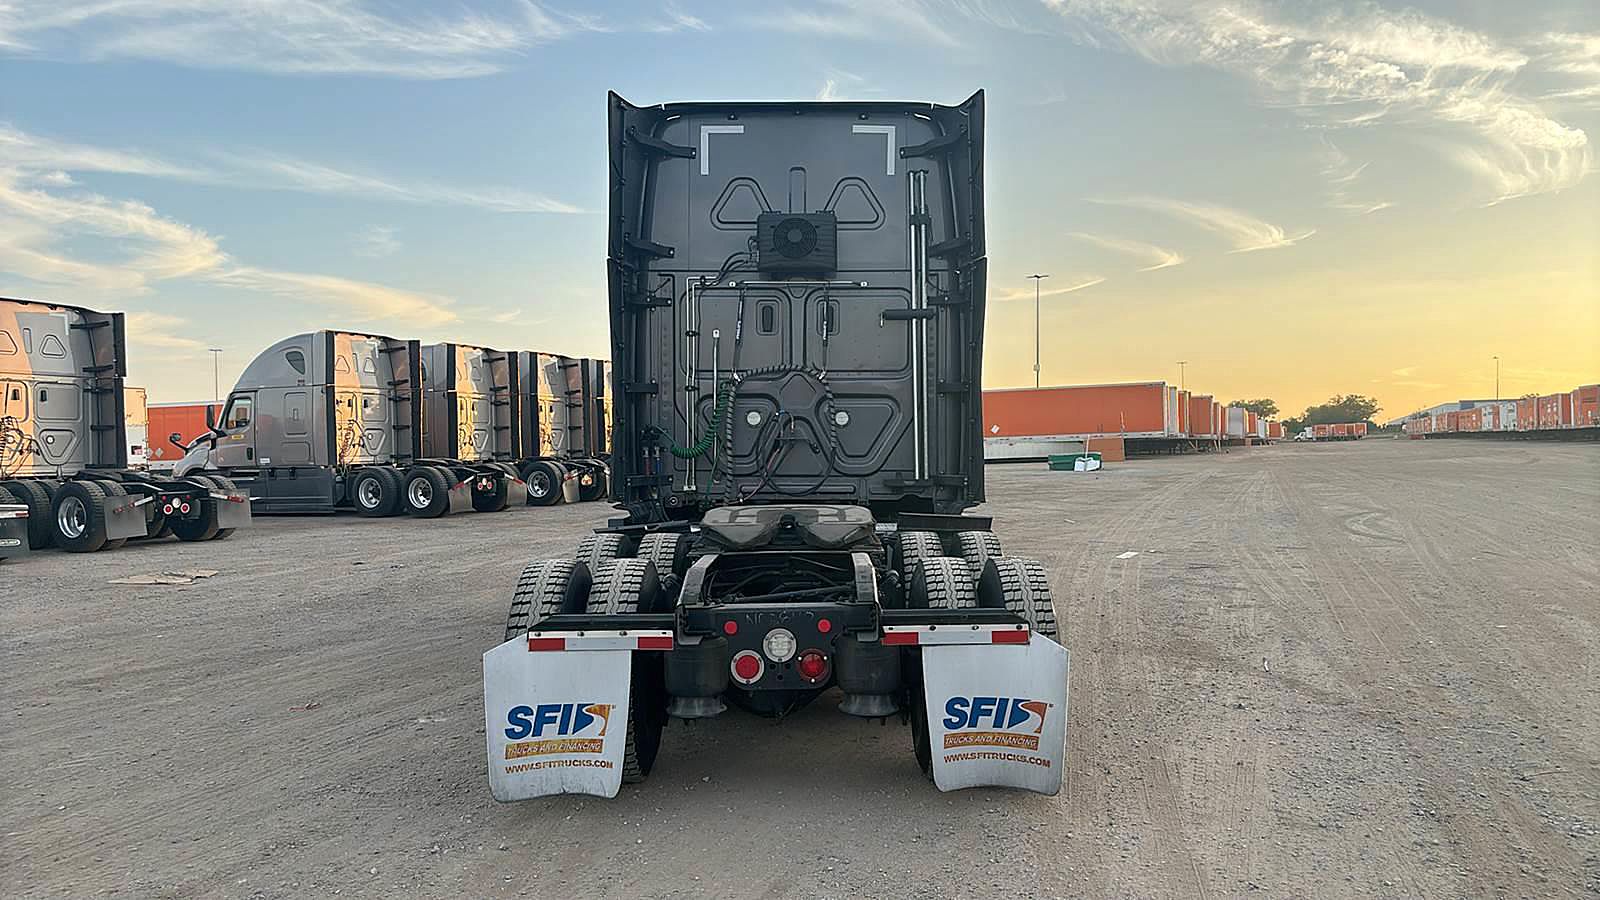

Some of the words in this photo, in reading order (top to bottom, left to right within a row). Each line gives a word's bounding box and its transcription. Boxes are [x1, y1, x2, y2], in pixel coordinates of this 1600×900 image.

[942, 697, 1010, 730] SFI
[504, 703, 574, 740] SFI
[507, 746, 540, 755] TRUCKS
[540, 743, 557, 752] AND
[559, 742, 601, 751] FINANCING
[945, 735, 974, 745] TRUCKS
[974, 735, 992, 744] AND
[993, 735, 1038, 747] FINANCING
[505, 759, 614, 774] WWW.SFITRUCKS.COM
[943, 752, 1051, 768] WWW.SFITRUCKS.COM
